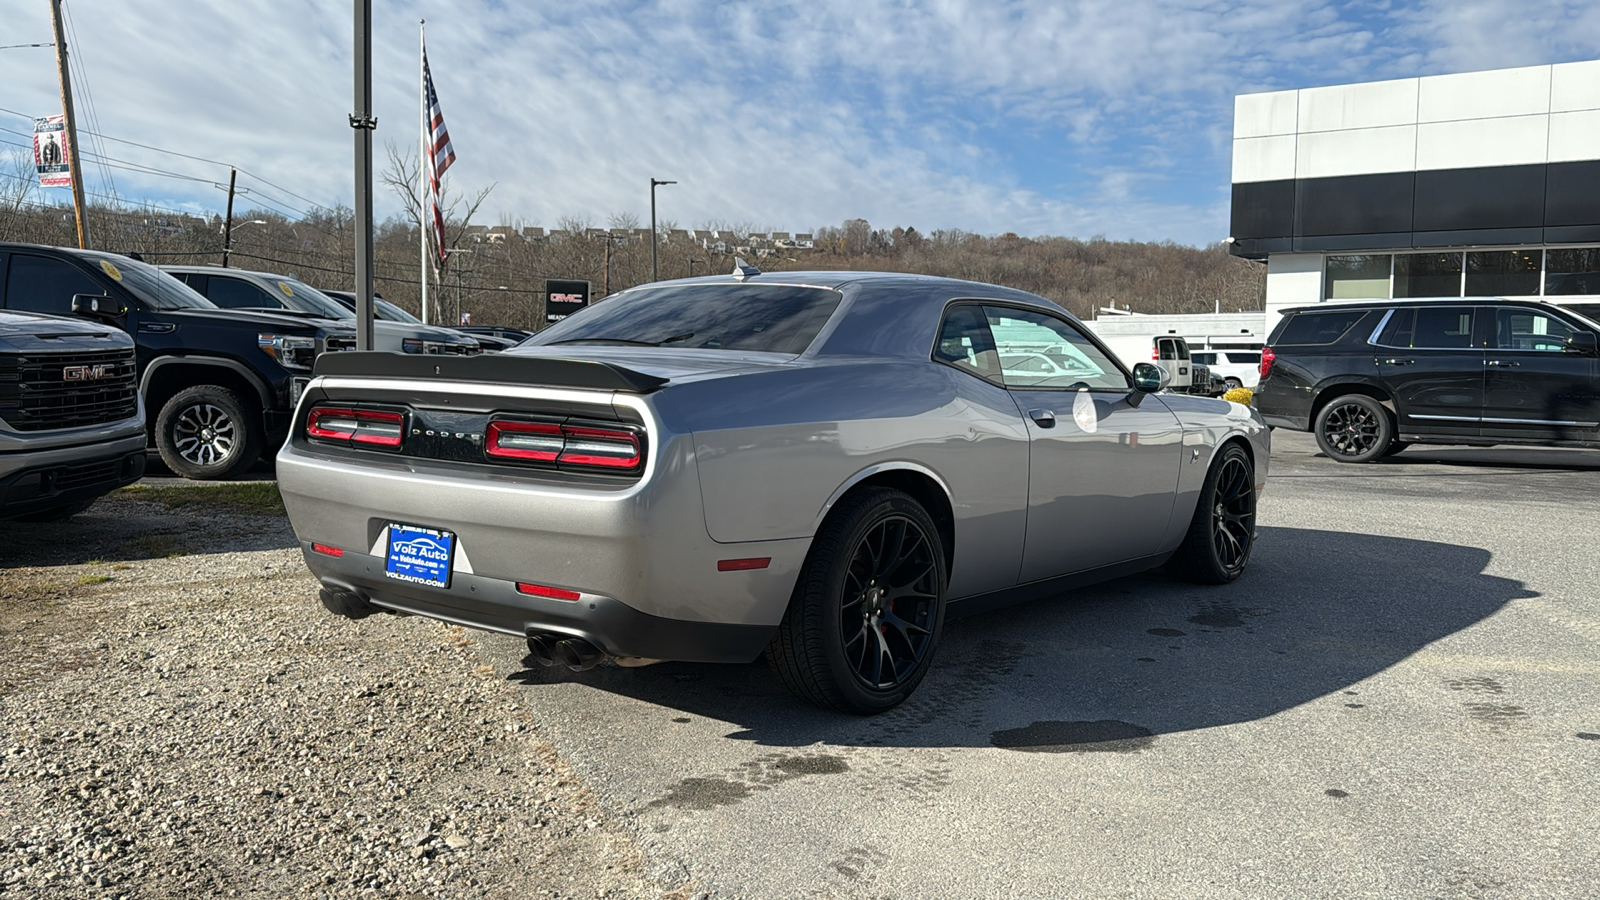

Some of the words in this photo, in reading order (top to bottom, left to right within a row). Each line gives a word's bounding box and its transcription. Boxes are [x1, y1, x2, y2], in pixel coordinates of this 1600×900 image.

[550, 293, 582, 303] GMC
[63, 364, 114, 381] GMC
[412, 428, 480, 440] DODGE
[393, 542, 418, 556] Volz
[418, 547, 449, 561] Auto
[399, 554, 439, 568] VolzAuto.com
[385, 570, 445, 588] VOLZAUTO.COM
